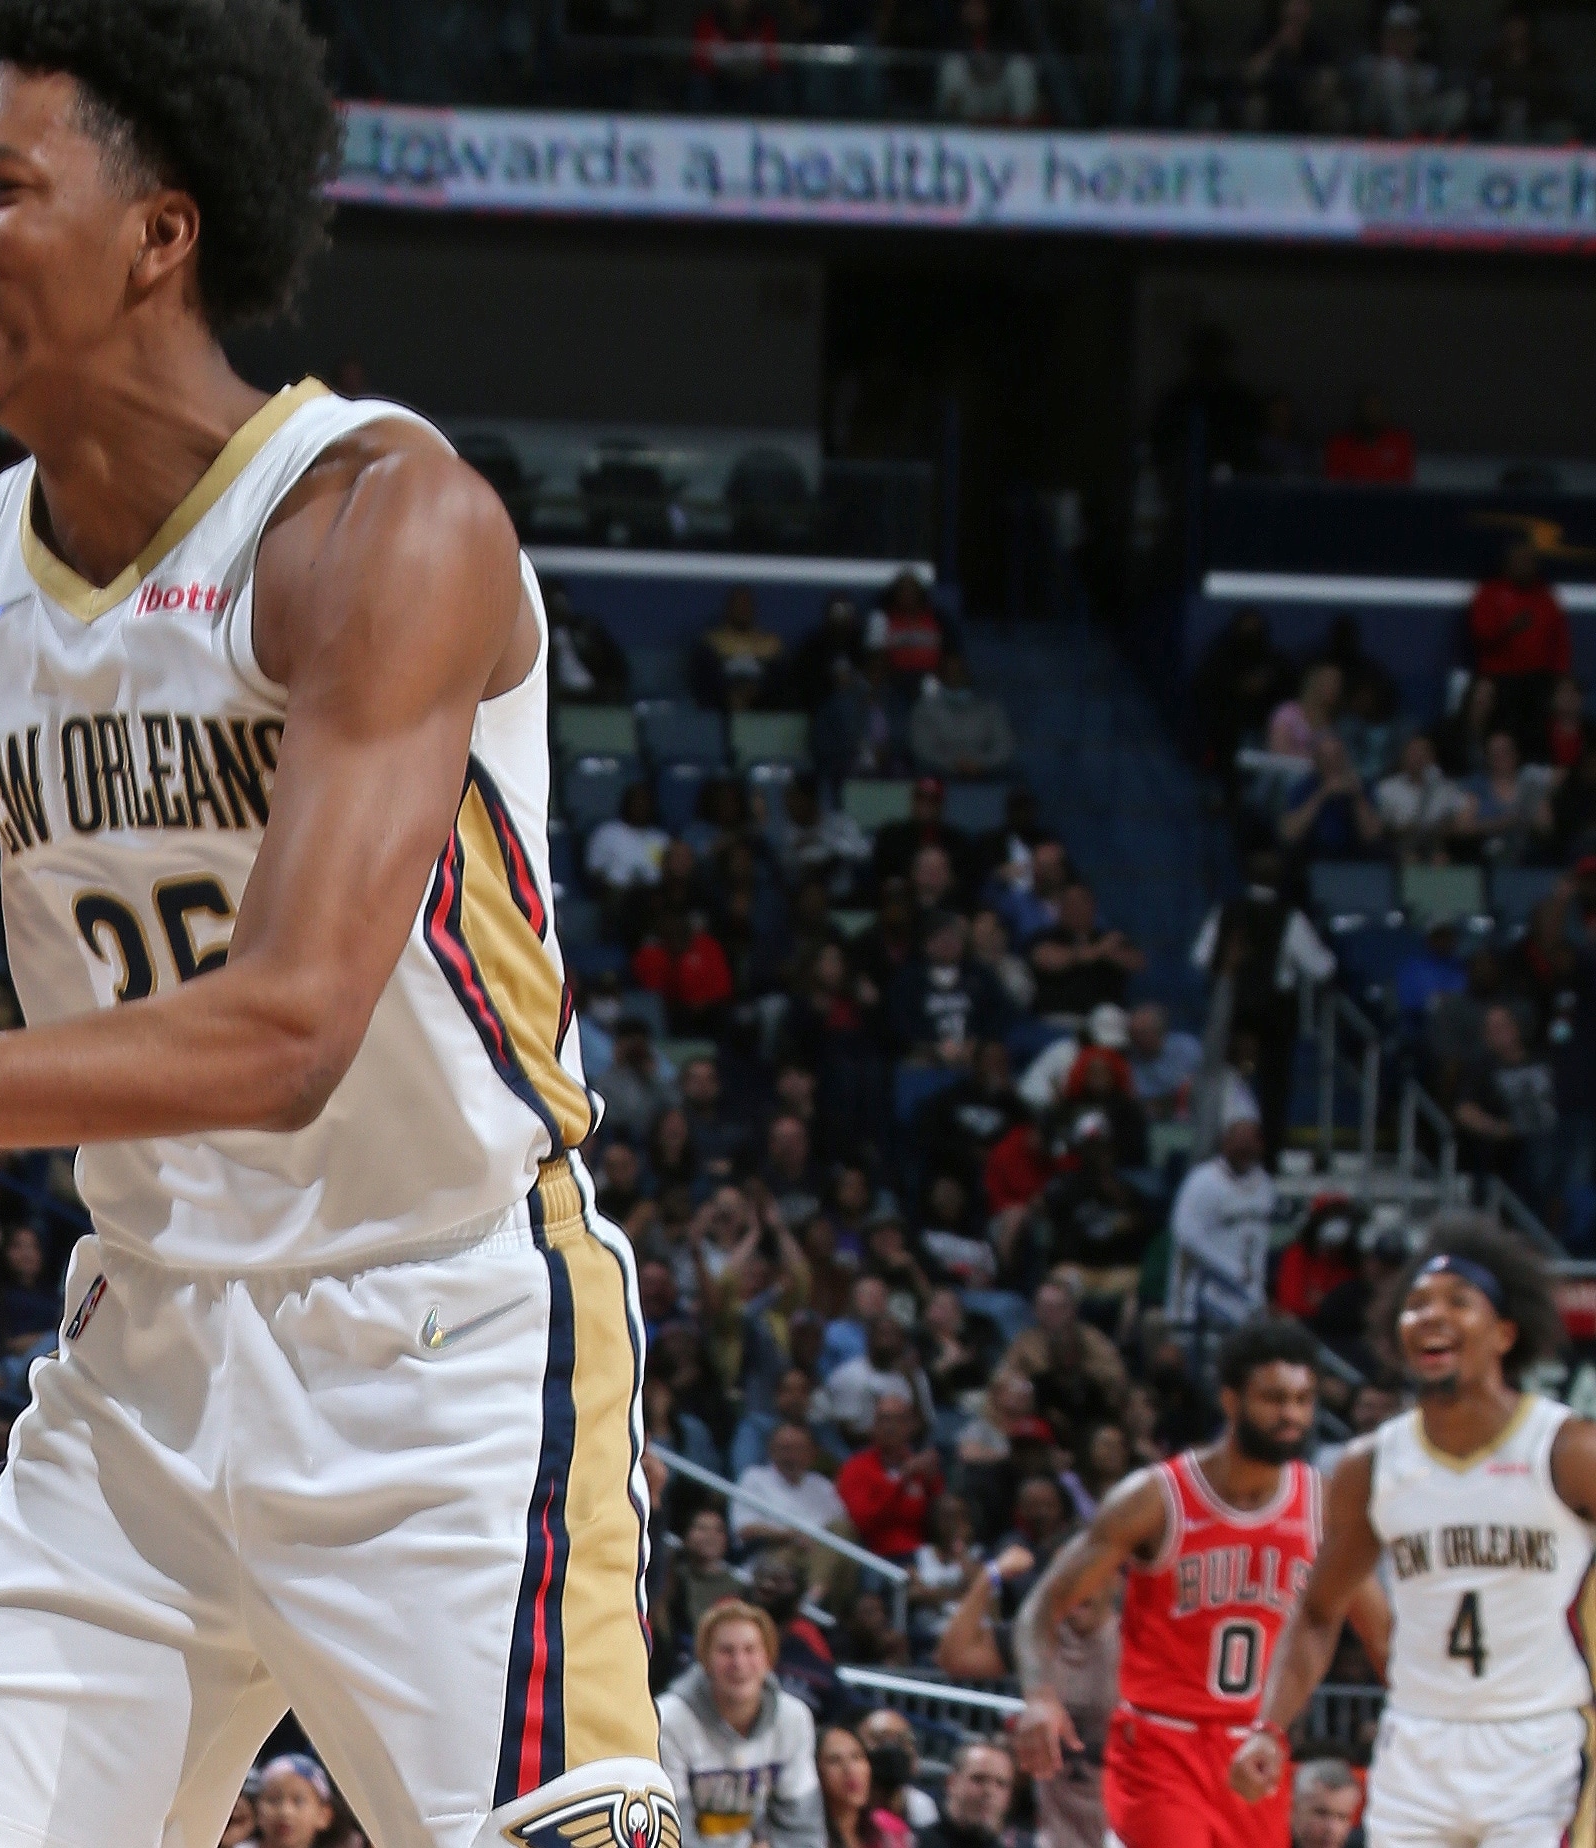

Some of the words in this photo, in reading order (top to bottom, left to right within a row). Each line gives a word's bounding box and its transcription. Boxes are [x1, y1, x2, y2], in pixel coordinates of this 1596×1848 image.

[368, 116, 656, 190] towards
[679, 138, 723, 195] a
[747, 122, 1016, 222] healthy
[1041, 135, 1247, 207] heart.
[1295, 150, 1450, 216] Visit
[1391, 1526, 1432, 1582] EW
[1441, 1522, 1557, 1574] ORLEANS
[1212, 1620, 1263, 1699] 0
[1448, 1588, 1488, 1678] 4
